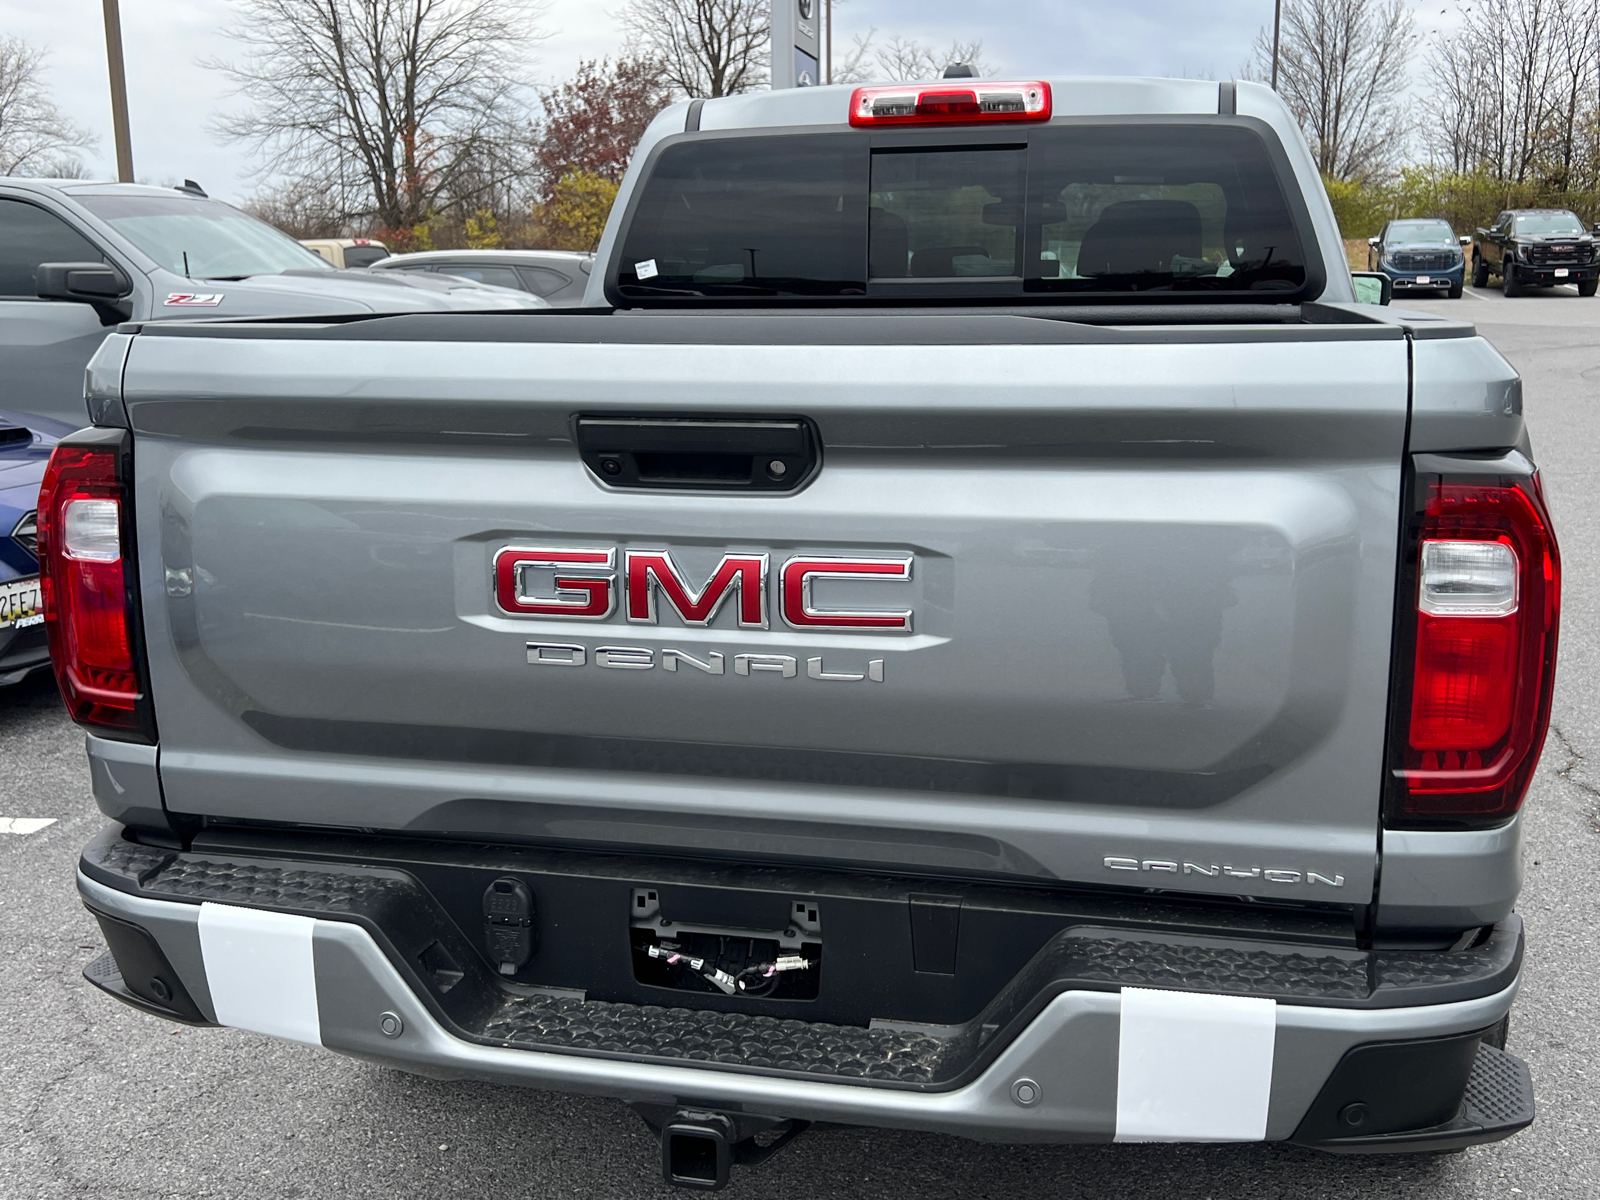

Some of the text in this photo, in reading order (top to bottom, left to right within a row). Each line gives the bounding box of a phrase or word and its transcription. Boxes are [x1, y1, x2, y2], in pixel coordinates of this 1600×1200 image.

[163, 292, 225, 307] Z71
[492, 545, 914, 632] GMC
[525, 641, 885, 682] DENALI
[1103, 855, 1345, 887] CANYON
